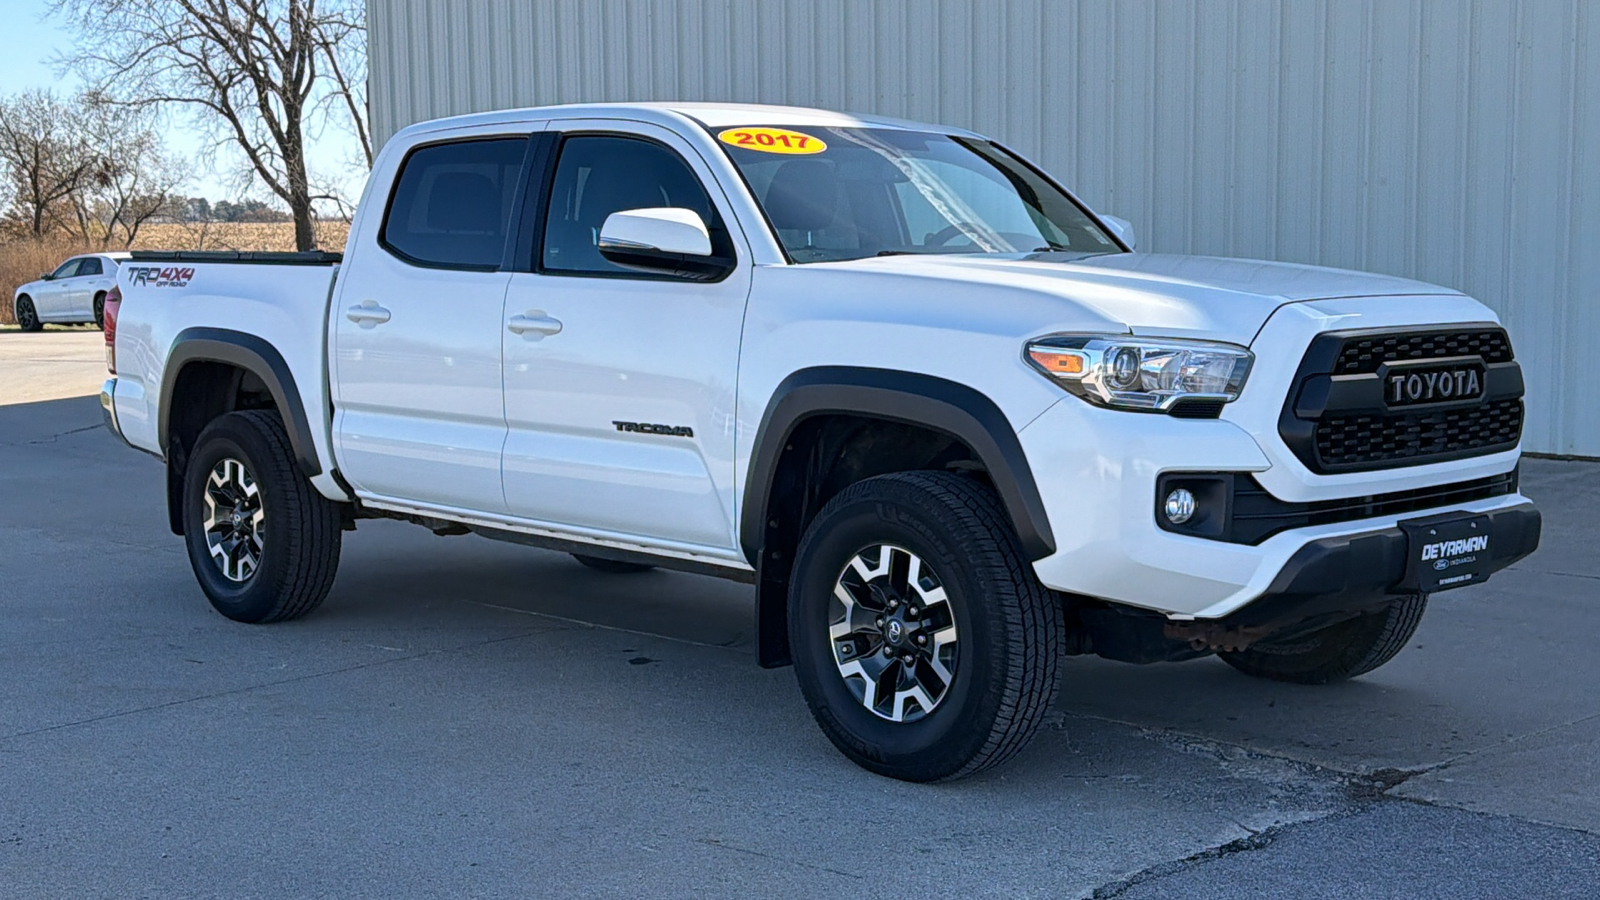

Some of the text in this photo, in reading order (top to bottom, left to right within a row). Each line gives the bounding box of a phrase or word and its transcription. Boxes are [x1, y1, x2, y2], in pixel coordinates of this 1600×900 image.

[734, 132, 809, 149] 2017
[1391, 369, 1480, 401] TOYOTA
[612, 420, 694, 438] TACOMA
[1421, 535, 1488, 561] DEYARMAN
